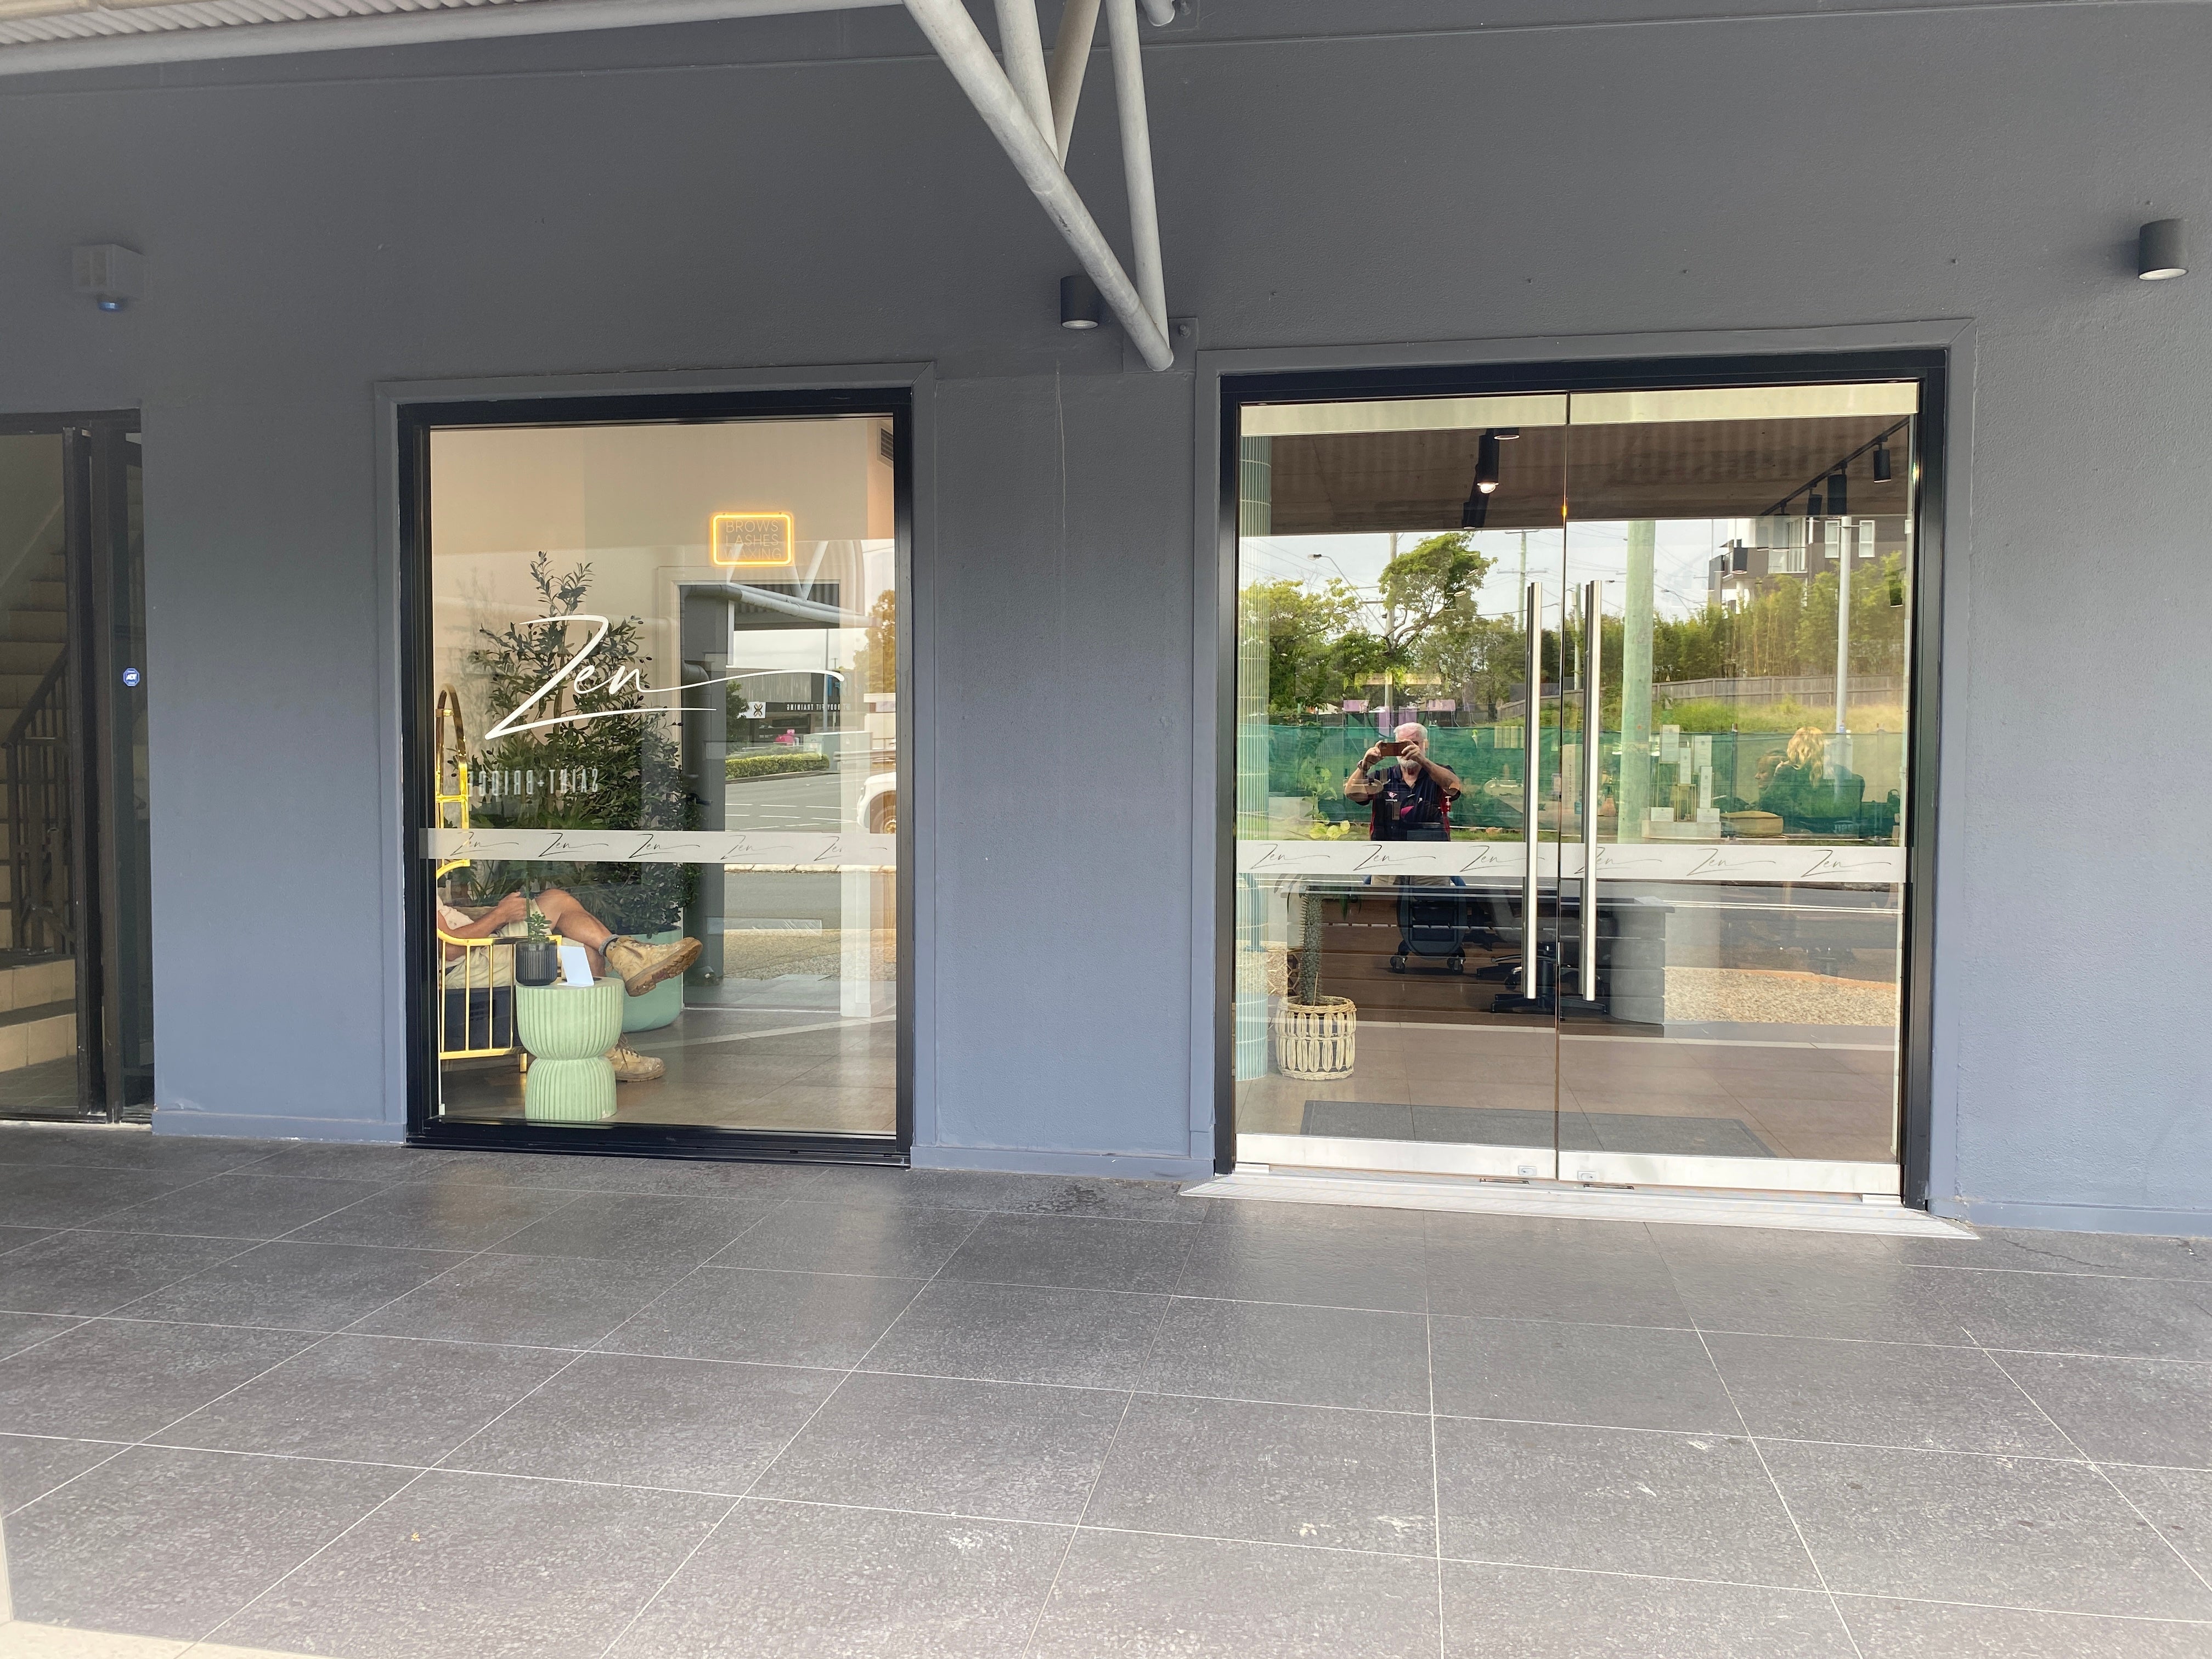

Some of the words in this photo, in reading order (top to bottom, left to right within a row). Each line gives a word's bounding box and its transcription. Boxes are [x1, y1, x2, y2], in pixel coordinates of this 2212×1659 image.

[726, 520, 778, 533] BROWS
[726, 534, 778, 547] LASHES
[724, 548, 781, 560] WAXING
[484, 614, 845, 740] Zen
[539, 832, 609, 857] Zen
[629, 833, 701, 859] Zen
[720, 834, 794, 860] Zen
[1250, 843, 1330, 870] Zen
[1353, 844, 1436, 871] Zen
[1459, 845, 1545, 873] Zen
[1686, 848, 1776, 877] Zen
[1801, 849, 1892, 878] Zen
